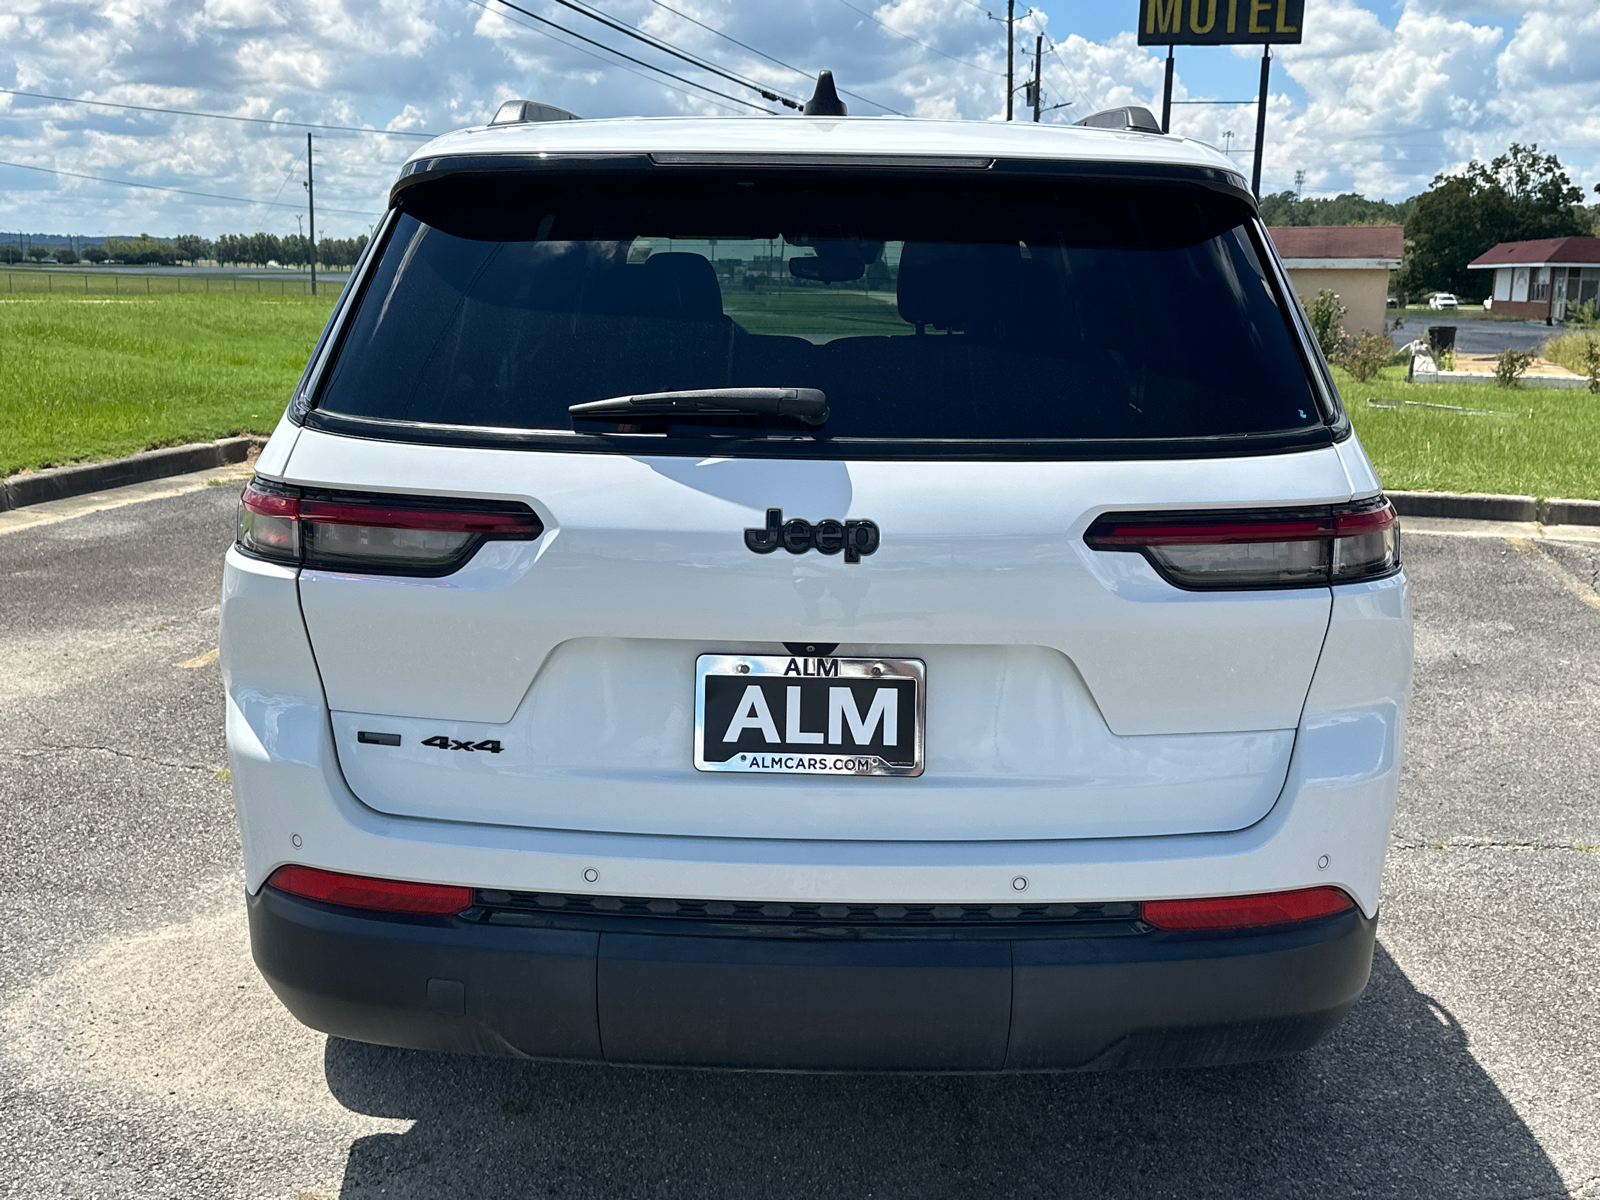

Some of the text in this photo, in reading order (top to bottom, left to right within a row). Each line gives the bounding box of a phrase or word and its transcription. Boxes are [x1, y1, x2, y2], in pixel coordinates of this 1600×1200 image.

[744, 508, 880, 564] Jeep
[784, 658, 839, 677] ALM
[722, 685, 898, 747] ALM
[749, 756, 869, 771] ALMCARS.COM
